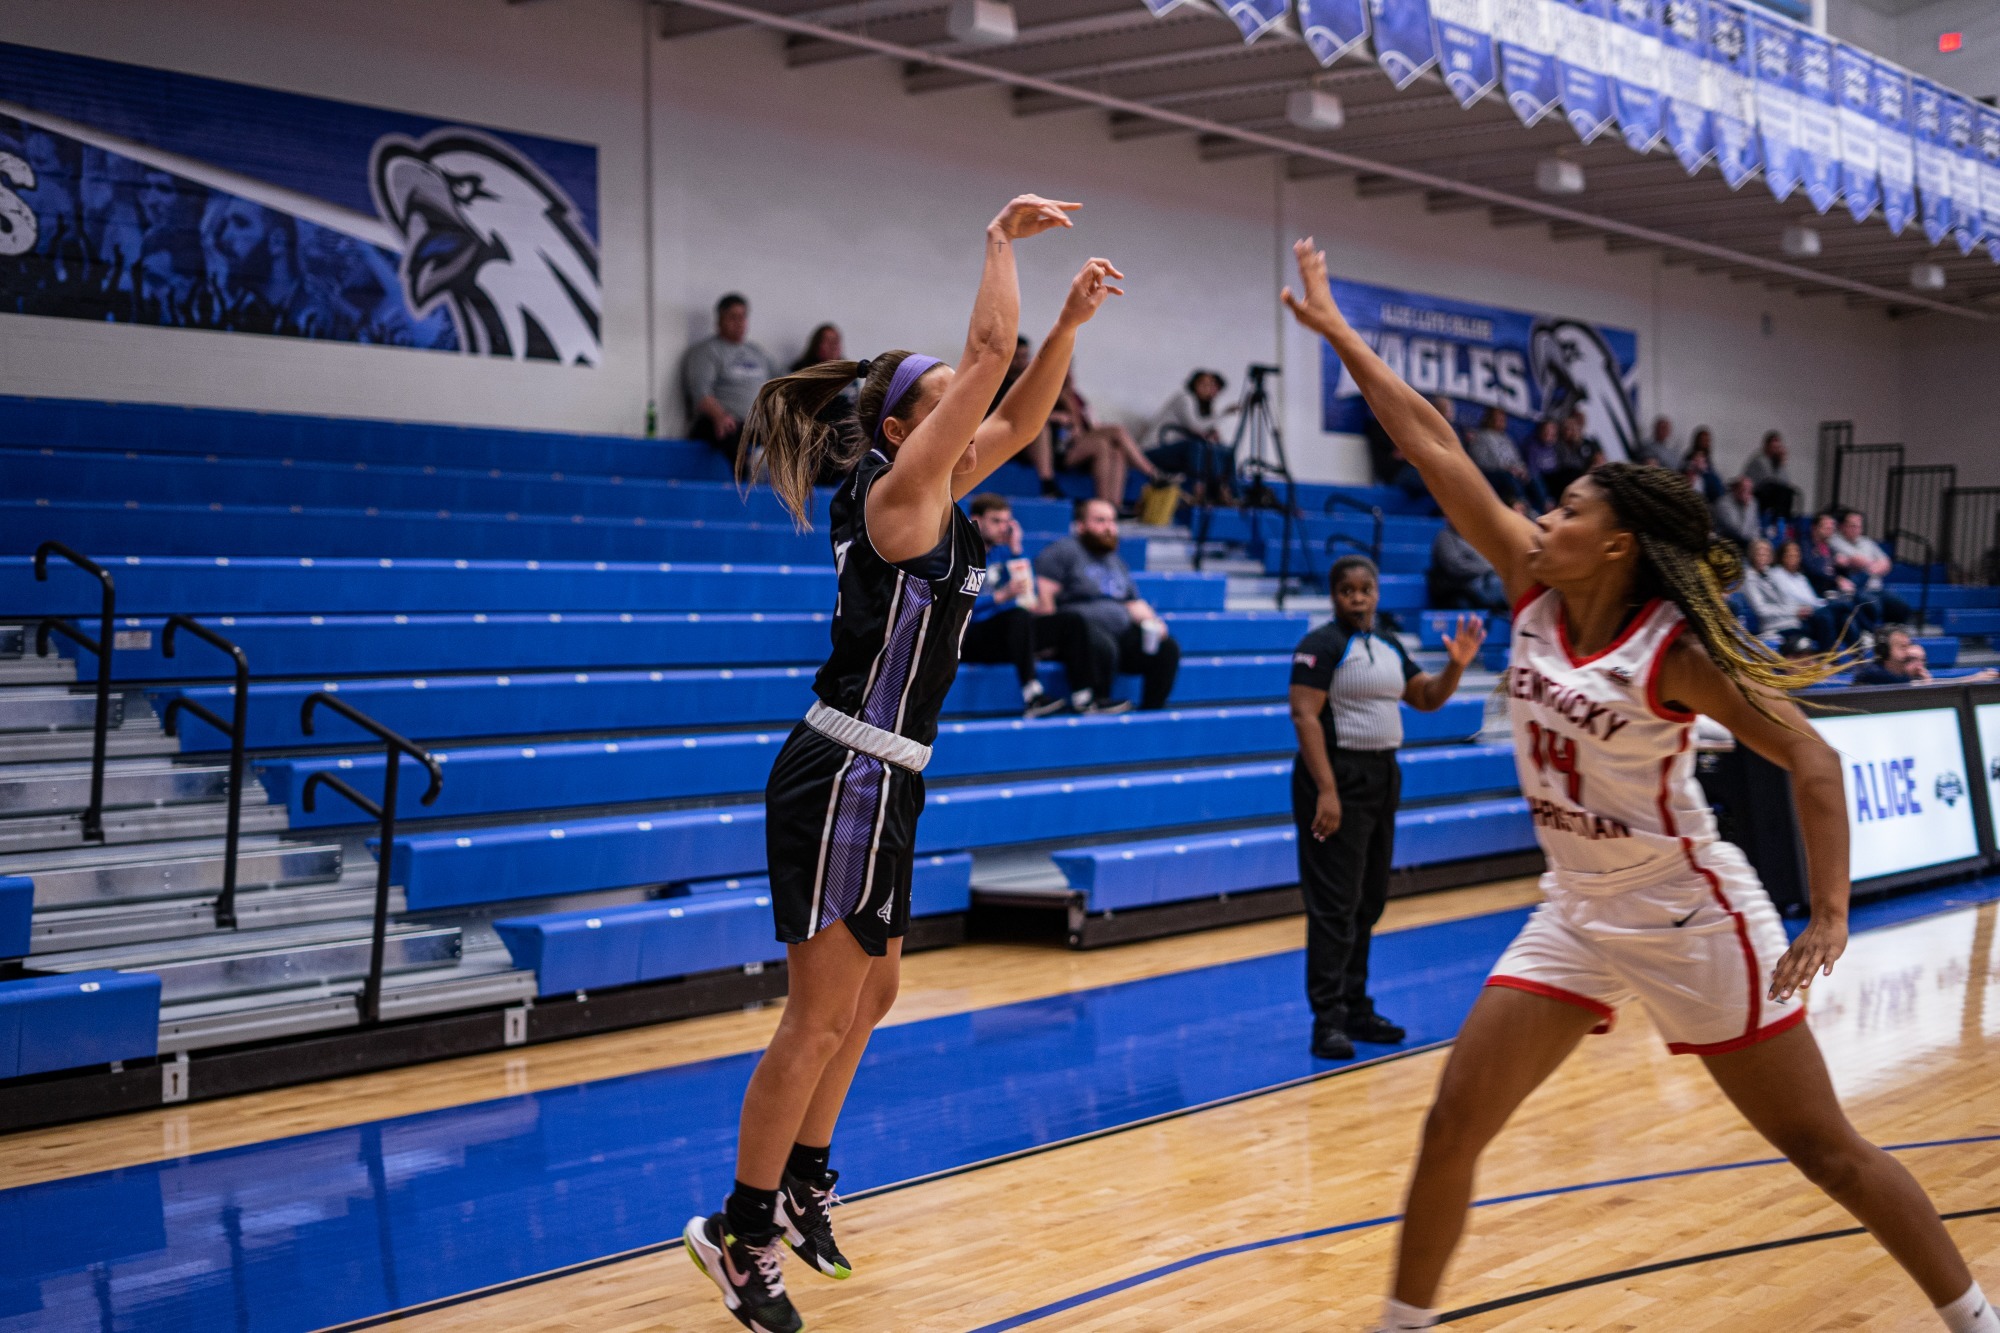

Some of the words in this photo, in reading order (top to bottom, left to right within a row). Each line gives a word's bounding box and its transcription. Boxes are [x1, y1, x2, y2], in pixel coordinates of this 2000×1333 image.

[1512, 668, 1629, 741] ENTUCKY
[1526, 721, 1581, 806] 14
[1852, 757, 1922, 823] ALICE
[1527, 796, 1631, 840] HRISTIAN
